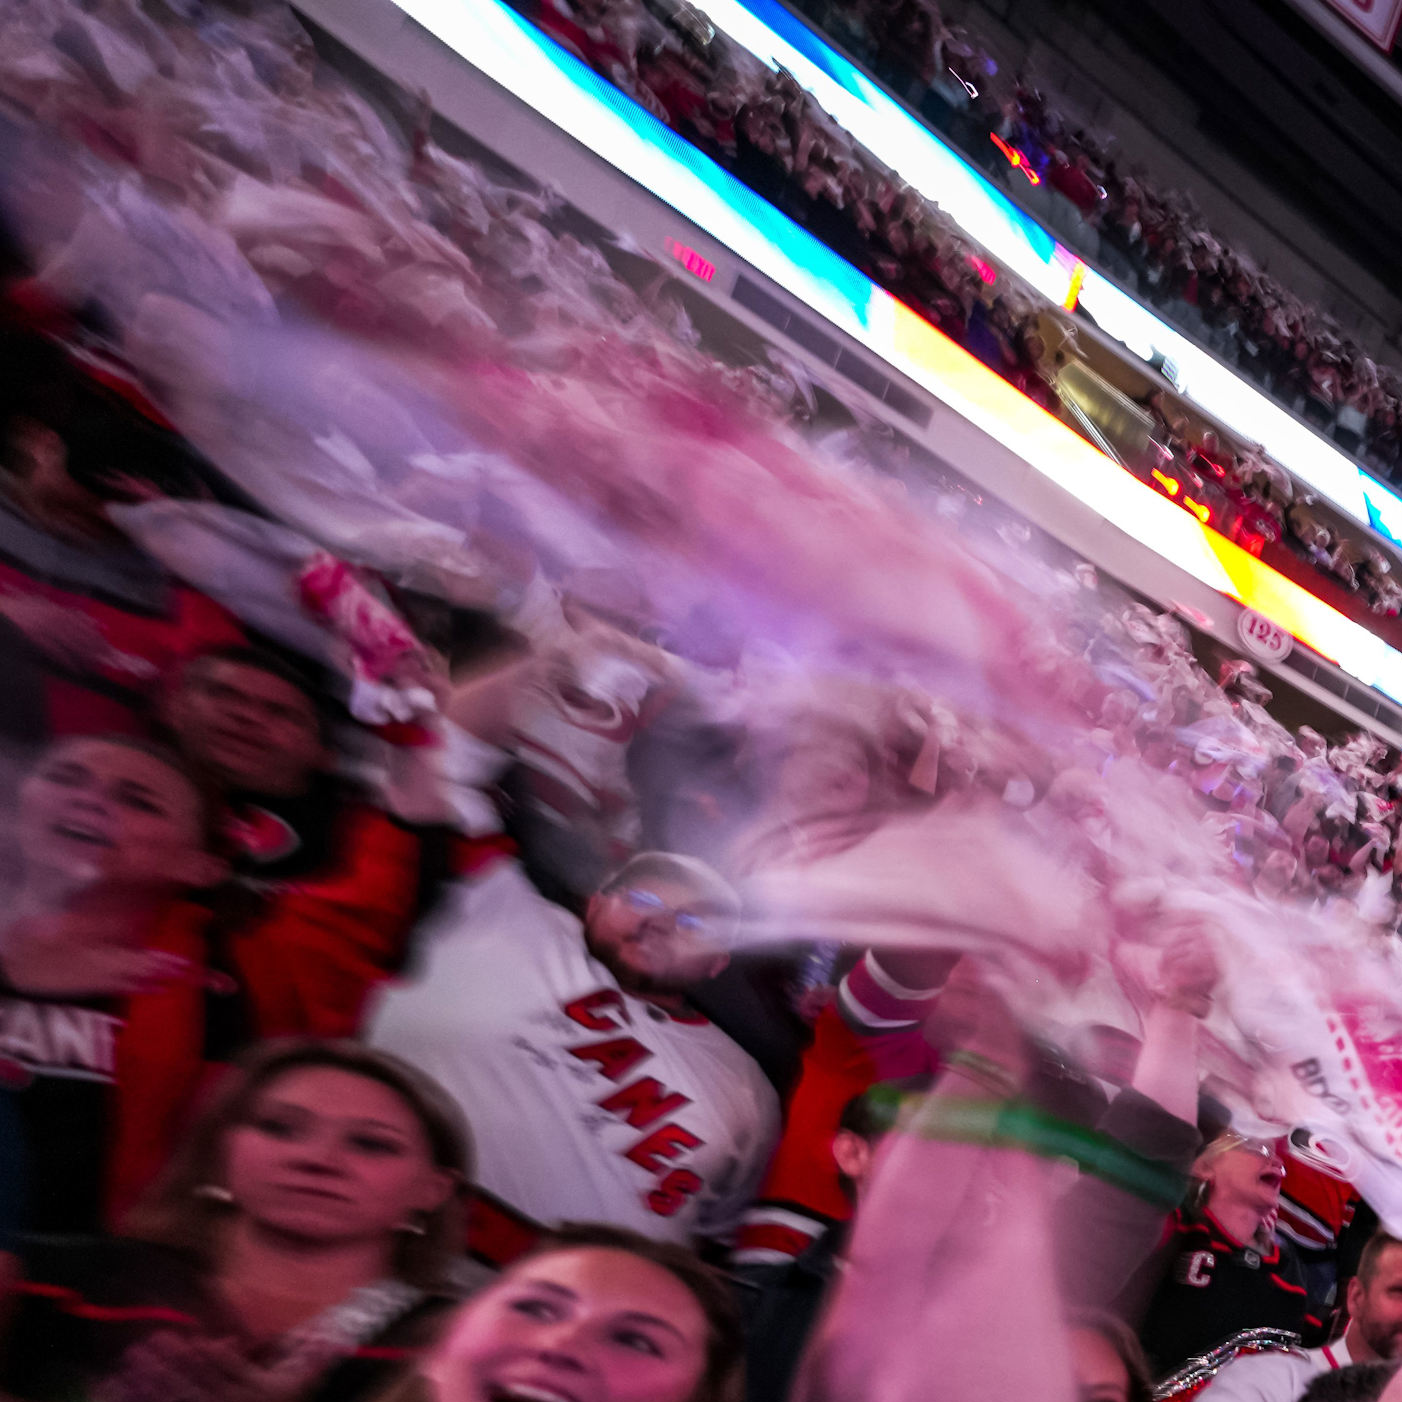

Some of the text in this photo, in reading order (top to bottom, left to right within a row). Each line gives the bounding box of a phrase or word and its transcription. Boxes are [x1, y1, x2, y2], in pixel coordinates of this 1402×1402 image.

[1247, 616, 1282, 651] 125
[562, 986, 707, 1218] CANES
[1186, 1249, 1216, 1288] C
